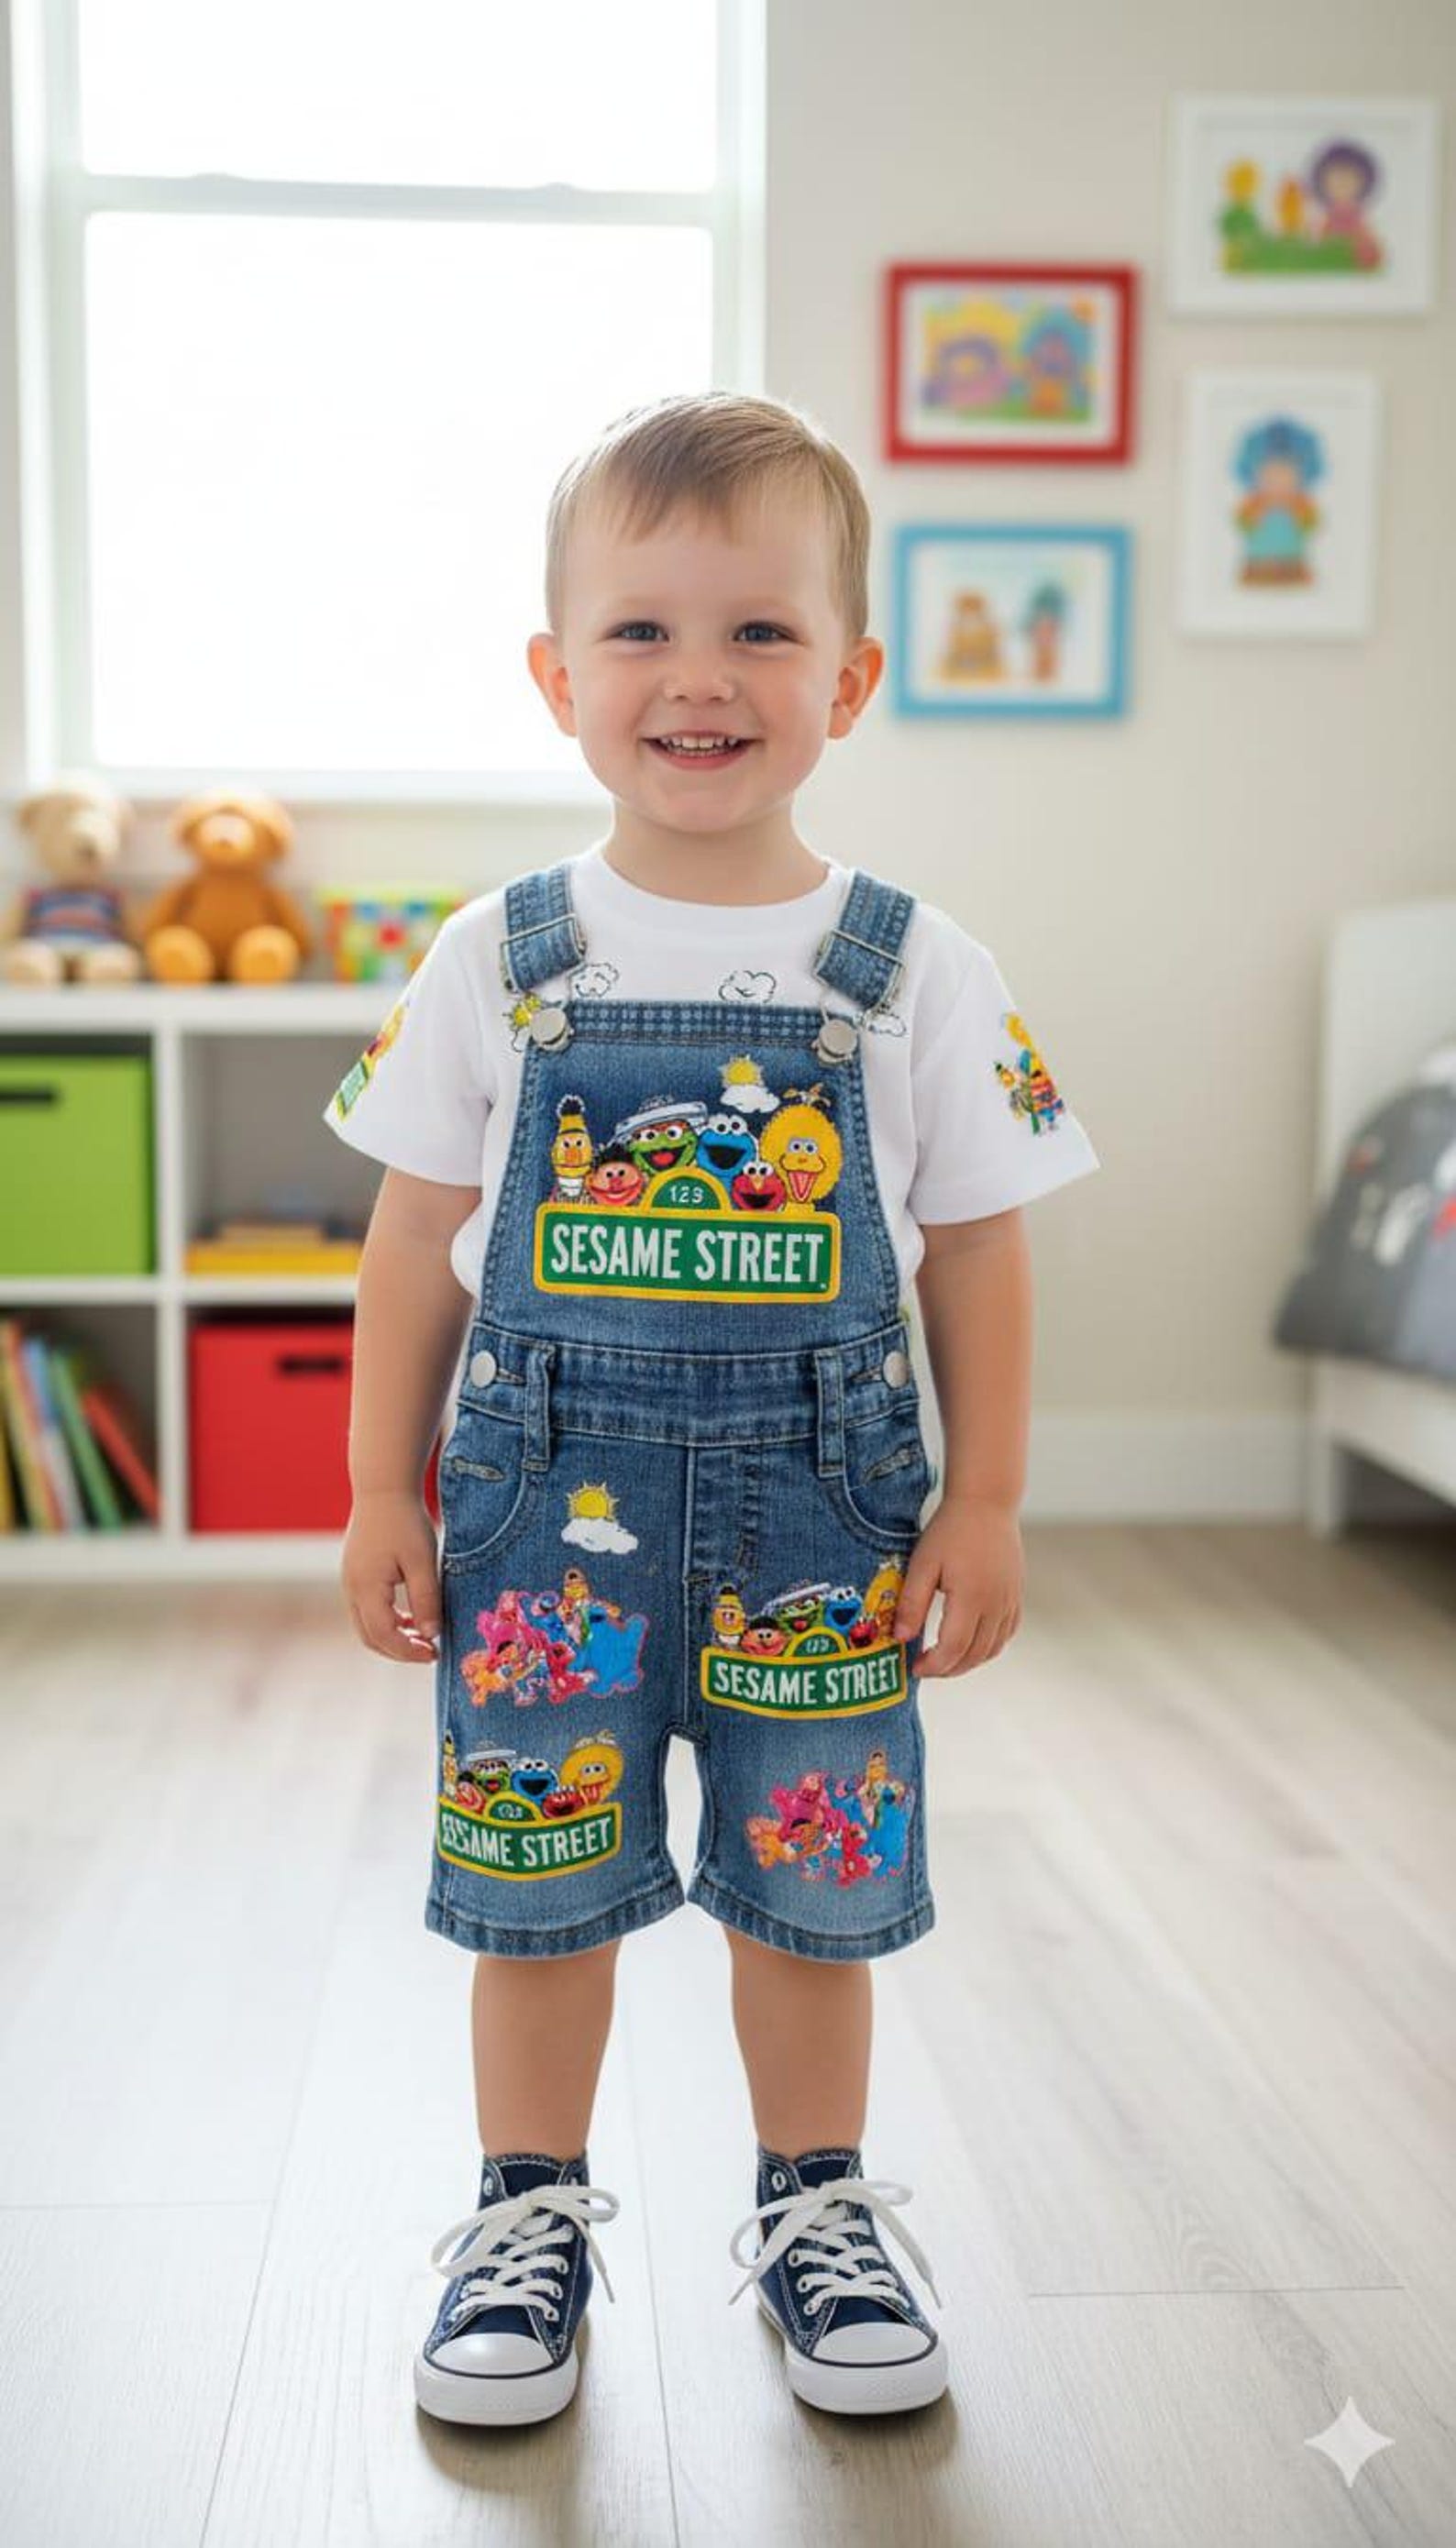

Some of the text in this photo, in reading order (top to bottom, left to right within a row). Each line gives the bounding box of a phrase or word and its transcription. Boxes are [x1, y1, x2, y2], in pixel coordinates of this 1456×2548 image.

[669, 1185, 704, 1204] 123
[551, 1223, 823, 1283] SESAME STREET
[714, 1653, 899, 1704] SESAME STREET
[522, 1816, 612, 1867] STREET
